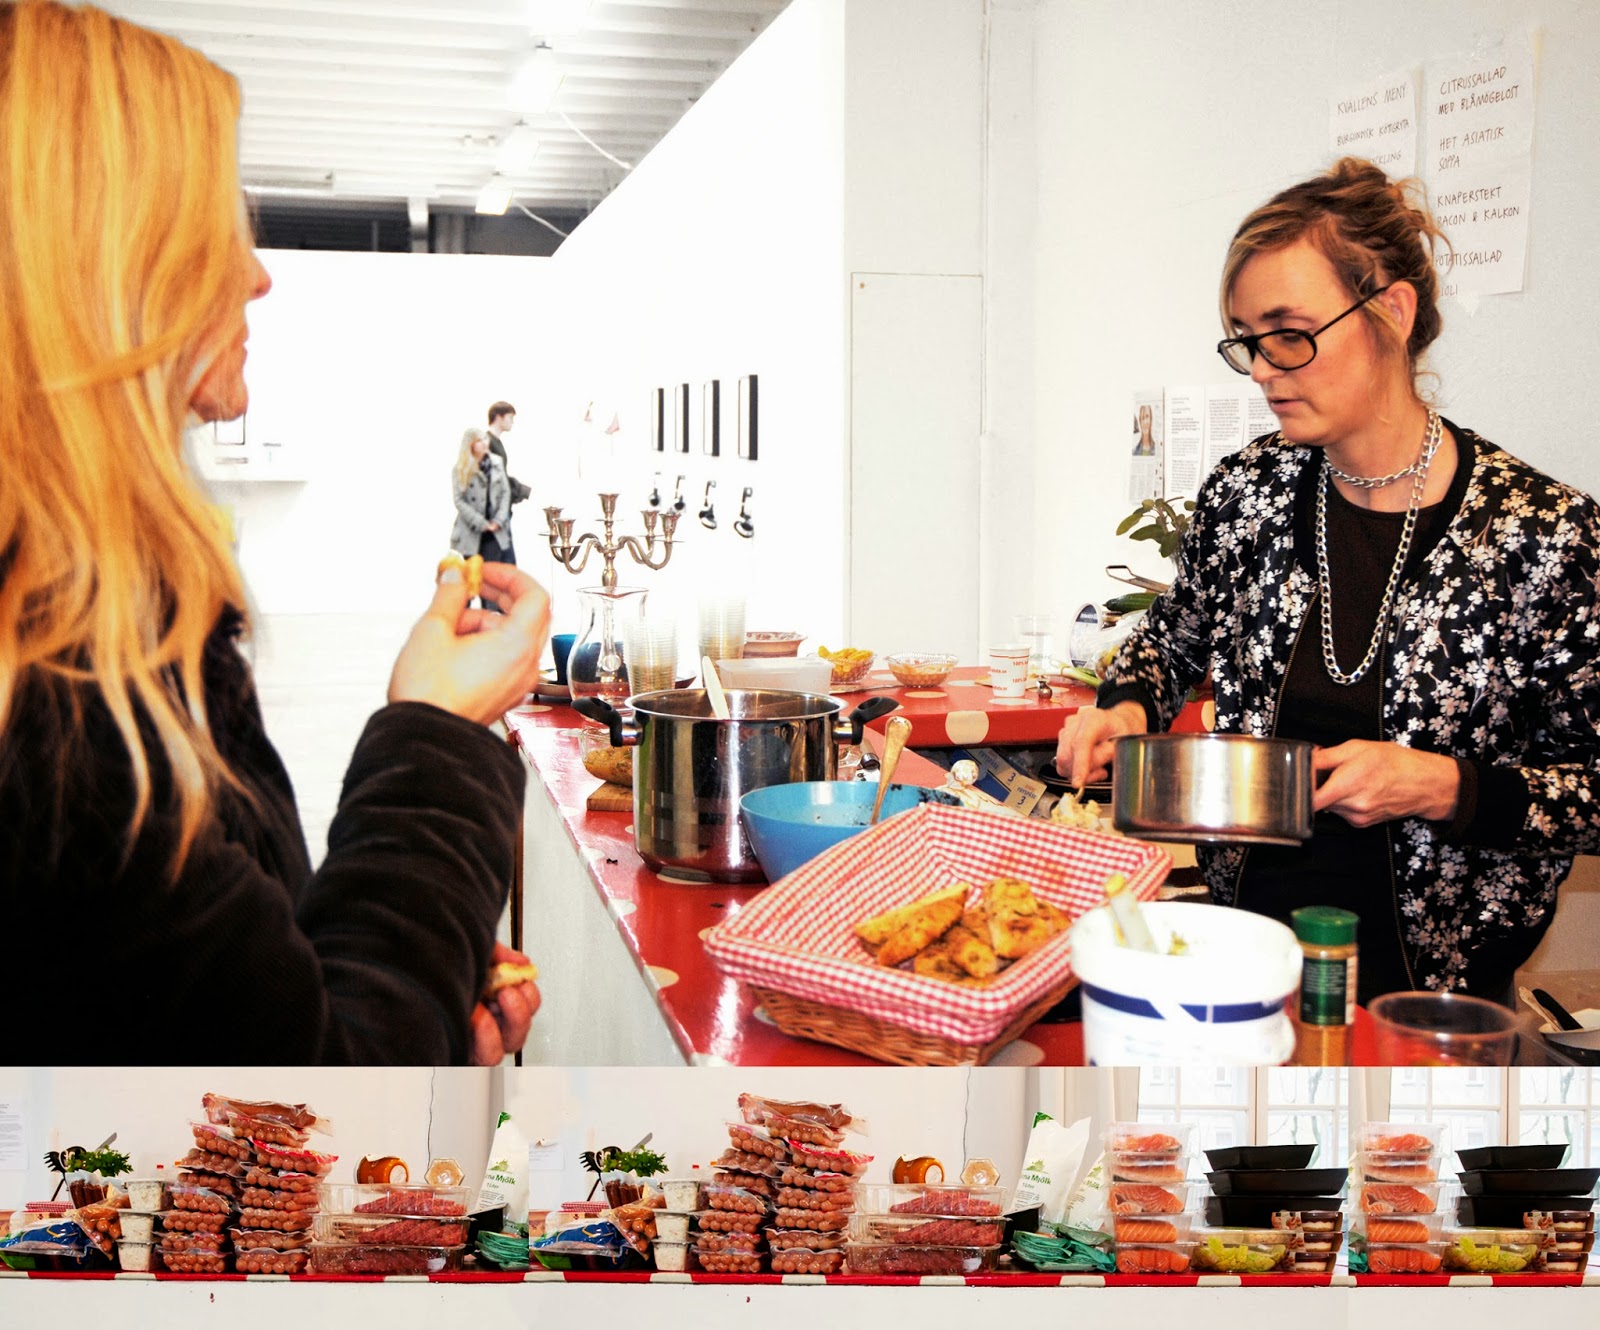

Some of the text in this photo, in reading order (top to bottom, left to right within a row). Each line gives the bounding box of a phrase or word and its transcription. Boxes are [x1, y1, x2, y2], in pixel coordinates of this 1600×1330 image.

[1440, 66, 1506, 95] CITRUSSALLAD
[1384, 81, 1406, 104] MENY
[1438, 102, 1455, 115] MED
[1440, 126, 1505, 151] HET ASIATISK
[1370, 150, 1402, 166] YCKLING
[1438, 154, 1460, 172] SOPPA
[1437, 186, 1502, 208] KNAPERSTEKT
[1437, 206, 1520, 227] BACON & KALKON
[1440, 283, 1458, 297] IOLI
[1007, 772, 1017, 782] 3
[1017, 795, 1027, 805] 3
[495, 1174, 516, 1186] Mjölk
[1031, 1174, 1052, 1185] Mjölk
